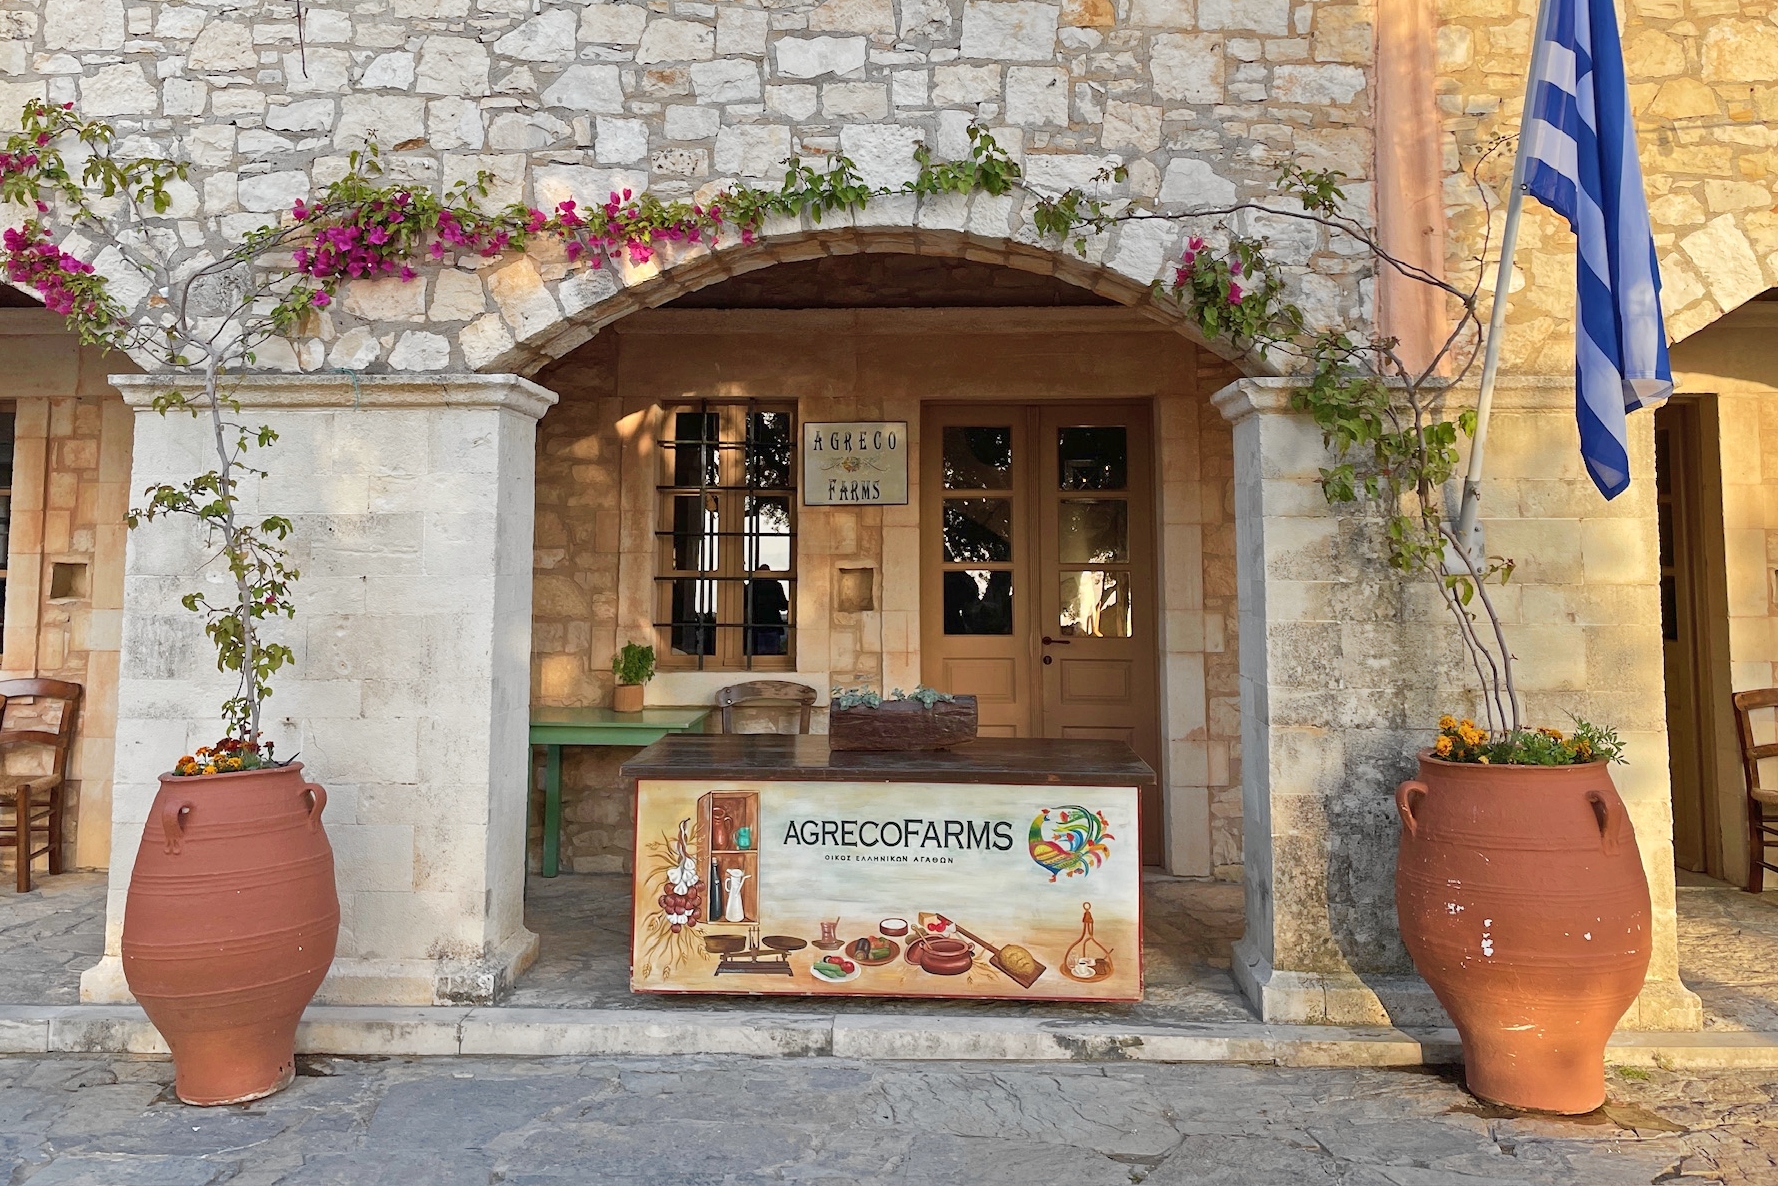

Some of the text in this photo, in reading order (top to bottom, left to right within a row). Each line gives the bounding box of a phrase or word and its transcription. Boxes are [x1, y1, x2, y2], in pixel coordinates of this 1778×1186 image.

[813, 431, 896, 453] AGRECO
[828, 479, 880, 502] FARMS
[783, 819, 1014, 851] AGRECOFARMS
[855, 855, 909, 863] ΕΛΛΗΝΙΚΩΝ
[913, 856, 955, 865] ΑΓΑΘΩΝ
